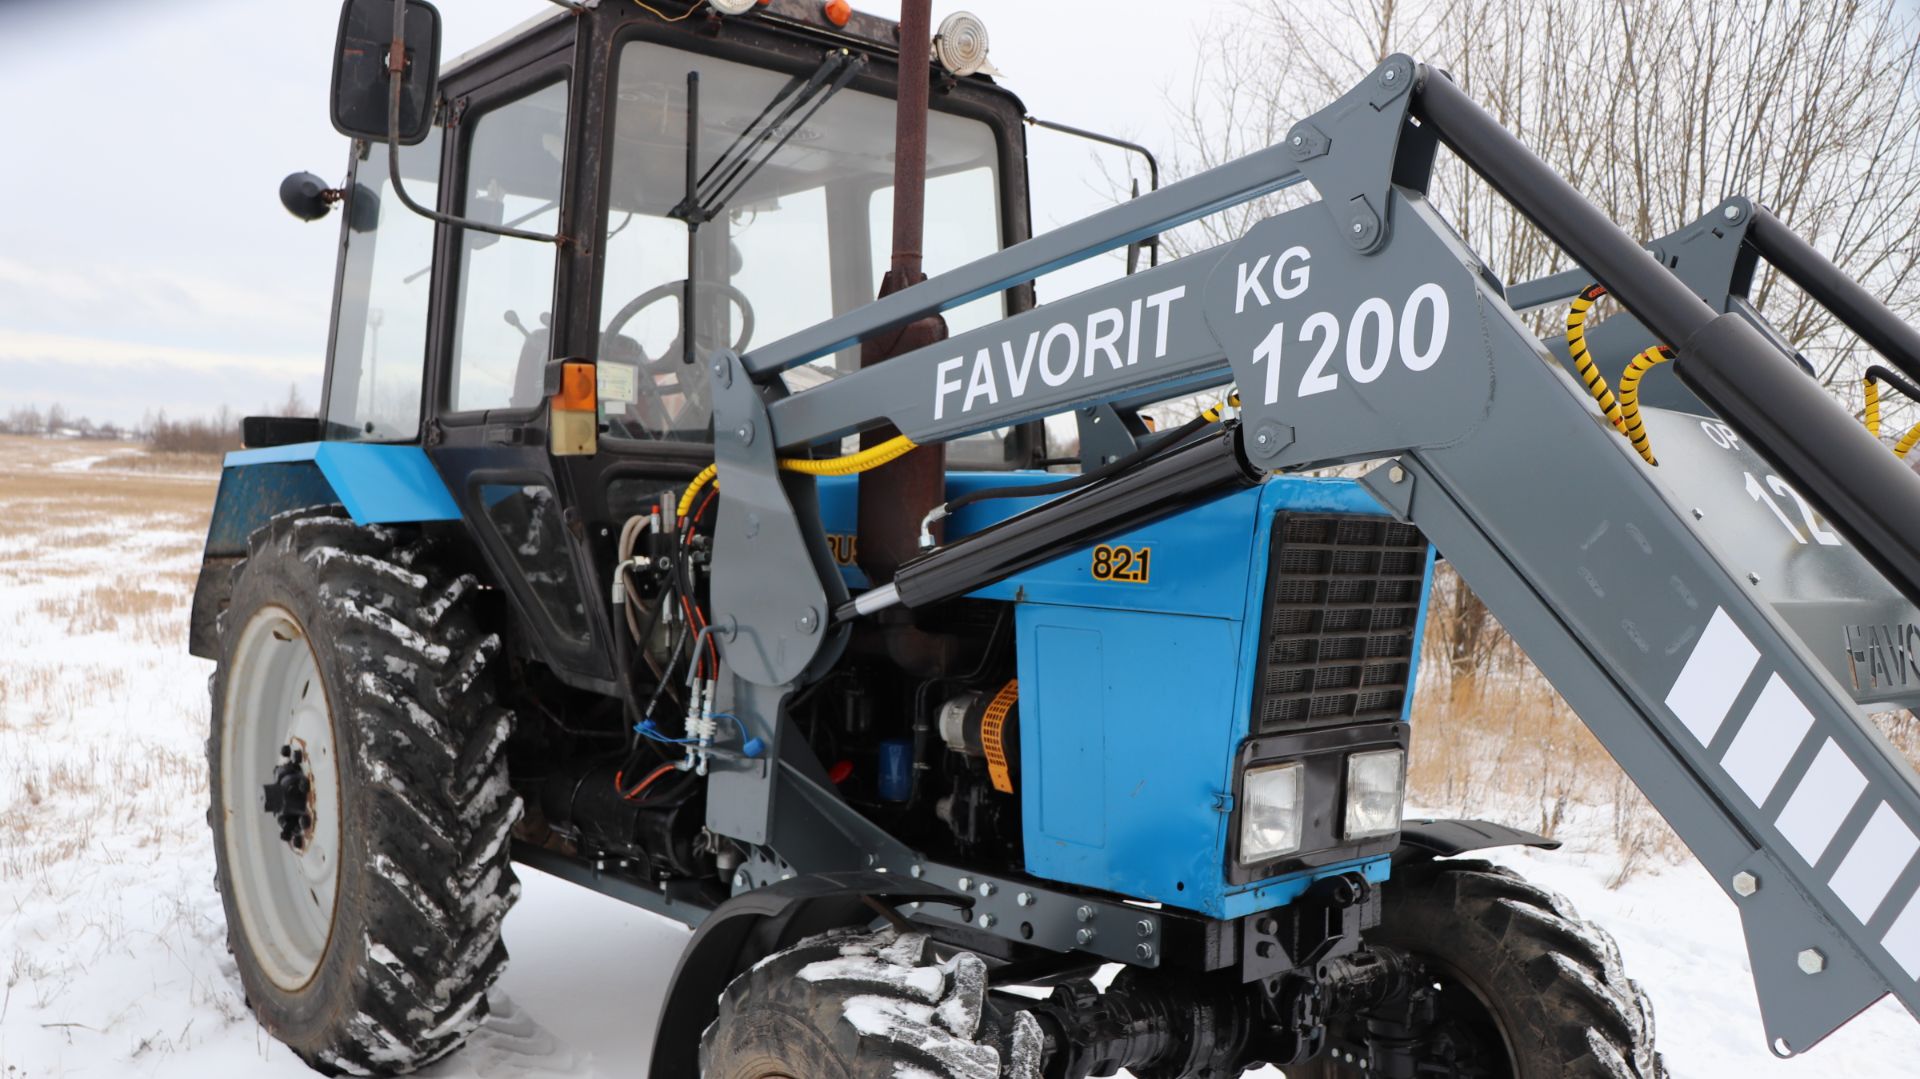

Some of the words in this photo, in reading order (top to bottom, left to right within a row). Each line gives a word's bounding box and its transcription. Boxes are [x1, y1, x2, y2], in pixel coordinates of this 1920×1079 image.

[1235, 246, 1311, 314] KG
[934, 285, 1186, 420] FAVORIT
[1251, 283, 1450, 405] 1200
[1091, 544, 1151, 583] 82.1
